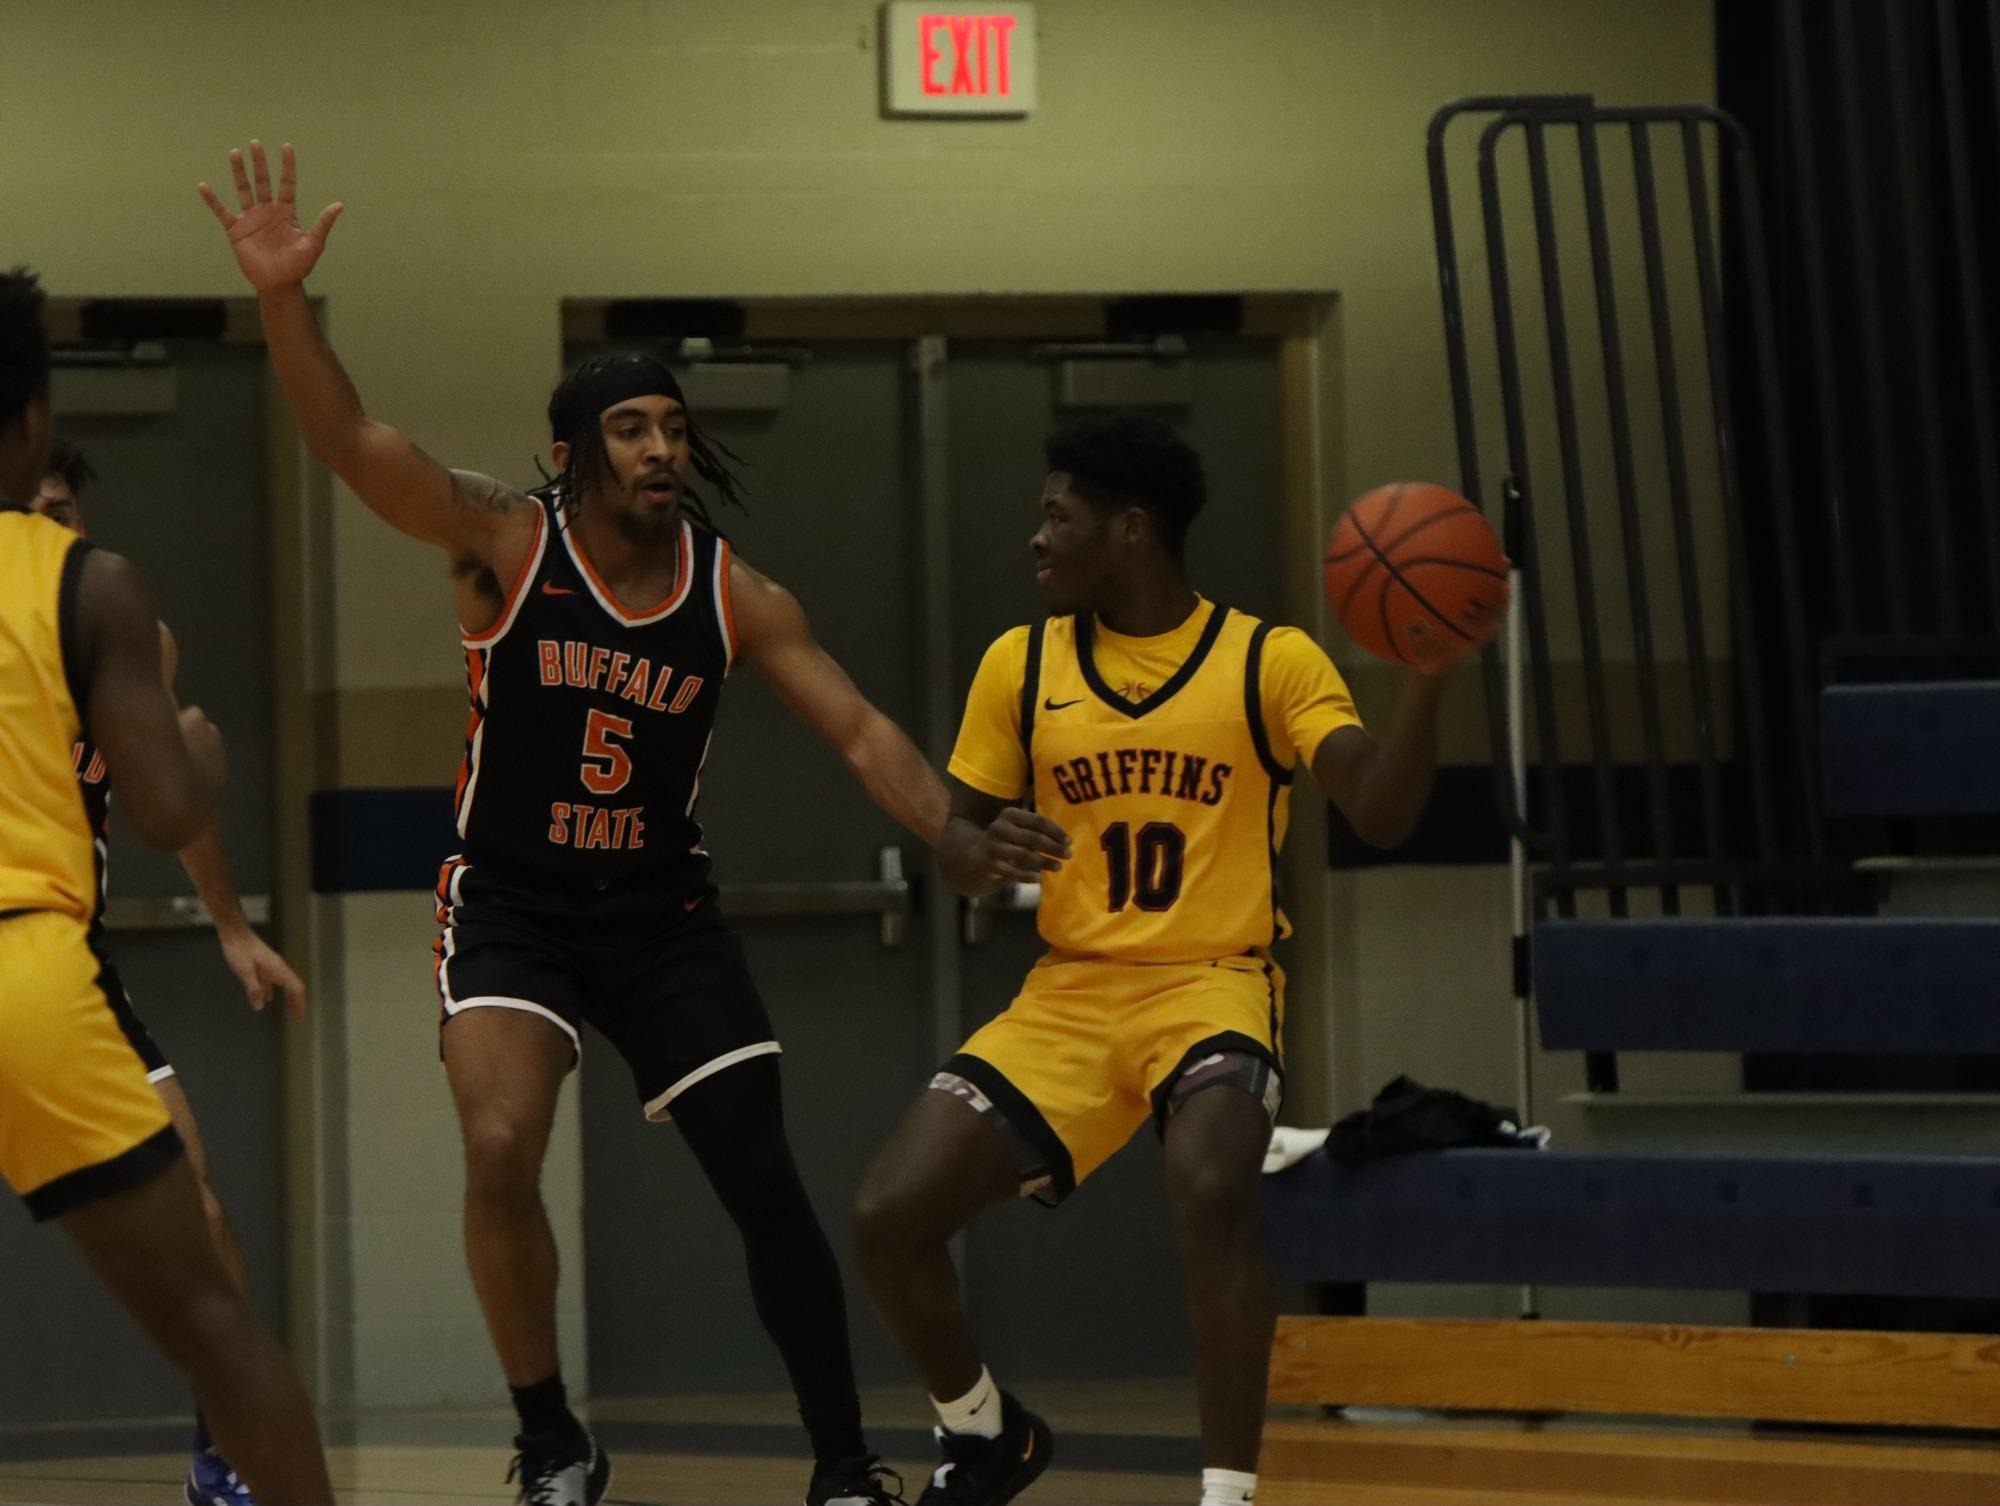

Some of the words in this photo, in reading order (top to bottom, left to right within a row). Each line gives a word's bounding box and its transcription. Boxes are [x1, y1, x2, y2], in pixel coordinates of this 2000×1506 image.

[920, 16, 1017, 95] EXIT
[537, 639, 704, 714] BUFFALO
[579, 707, 634, 795] 5
[1052, 749, 1234, 806] GRIFFINS
[548, 801, 645, 849] STATE
[1100, 821, 1186, 913] 10
